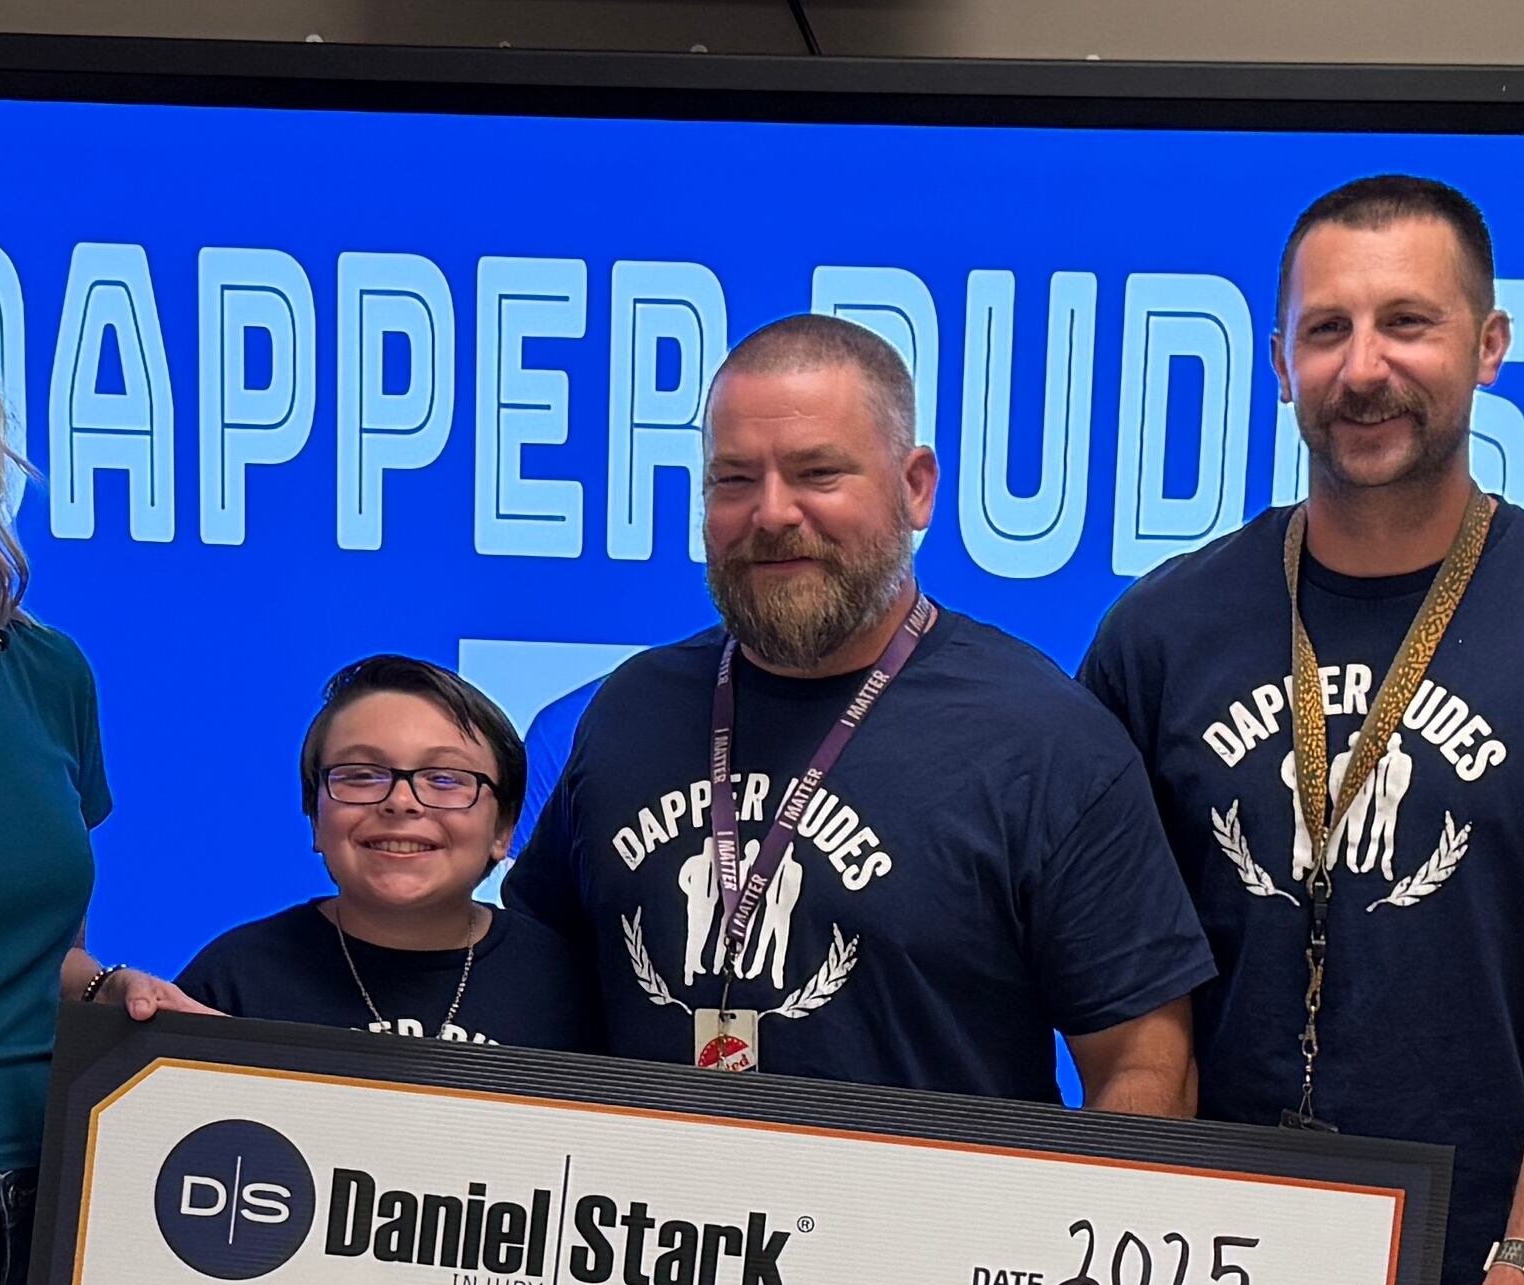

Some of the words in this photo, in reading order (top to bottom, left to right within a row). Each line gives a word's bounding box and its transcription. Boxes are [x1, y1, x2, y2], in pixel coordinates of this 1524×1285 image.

[845, 669, 891, 721] MATTER
[1201, 662, 1373, 768] DAPER
[1402, 678, 1508, 783] UDES
[783, 767, 824, 821] MATTER
[611, 772, 771, 872] DAPPR
[775, 776, 893, 892] UDES
[717, 838, 738, 893] MATTER
[733, 873, 769, 930] MATTER
[324, 1166, 552, 1278] Daniel
